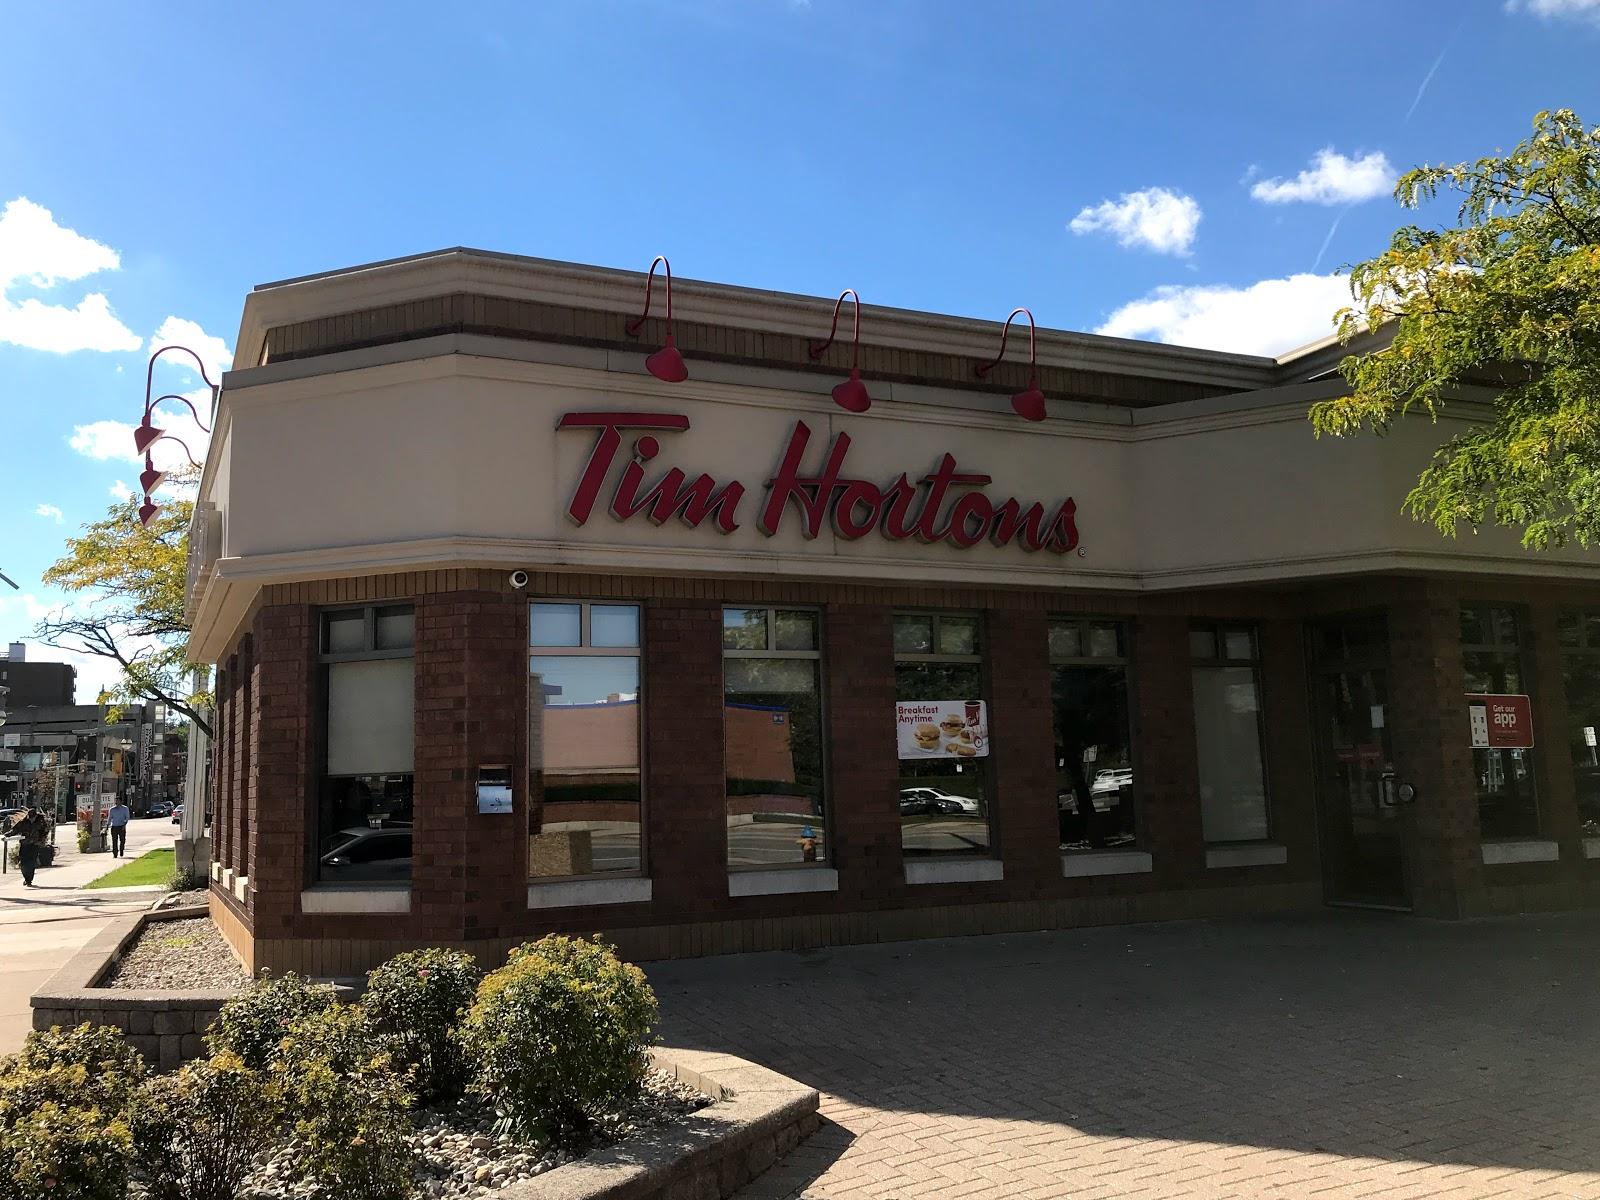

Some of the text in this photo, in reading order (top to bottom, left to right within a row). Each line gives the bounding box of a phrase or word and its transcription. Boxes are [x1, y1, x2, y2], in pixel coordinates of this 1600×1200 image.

[556, 412, 1080, 554] Tim Hortons
[898, 706, 939, 714] Breakfast
[1492, 704, 1504, 712] Get
[898, 714, 934, 724] Anytime
[1494, 713, 1517, 727] app
